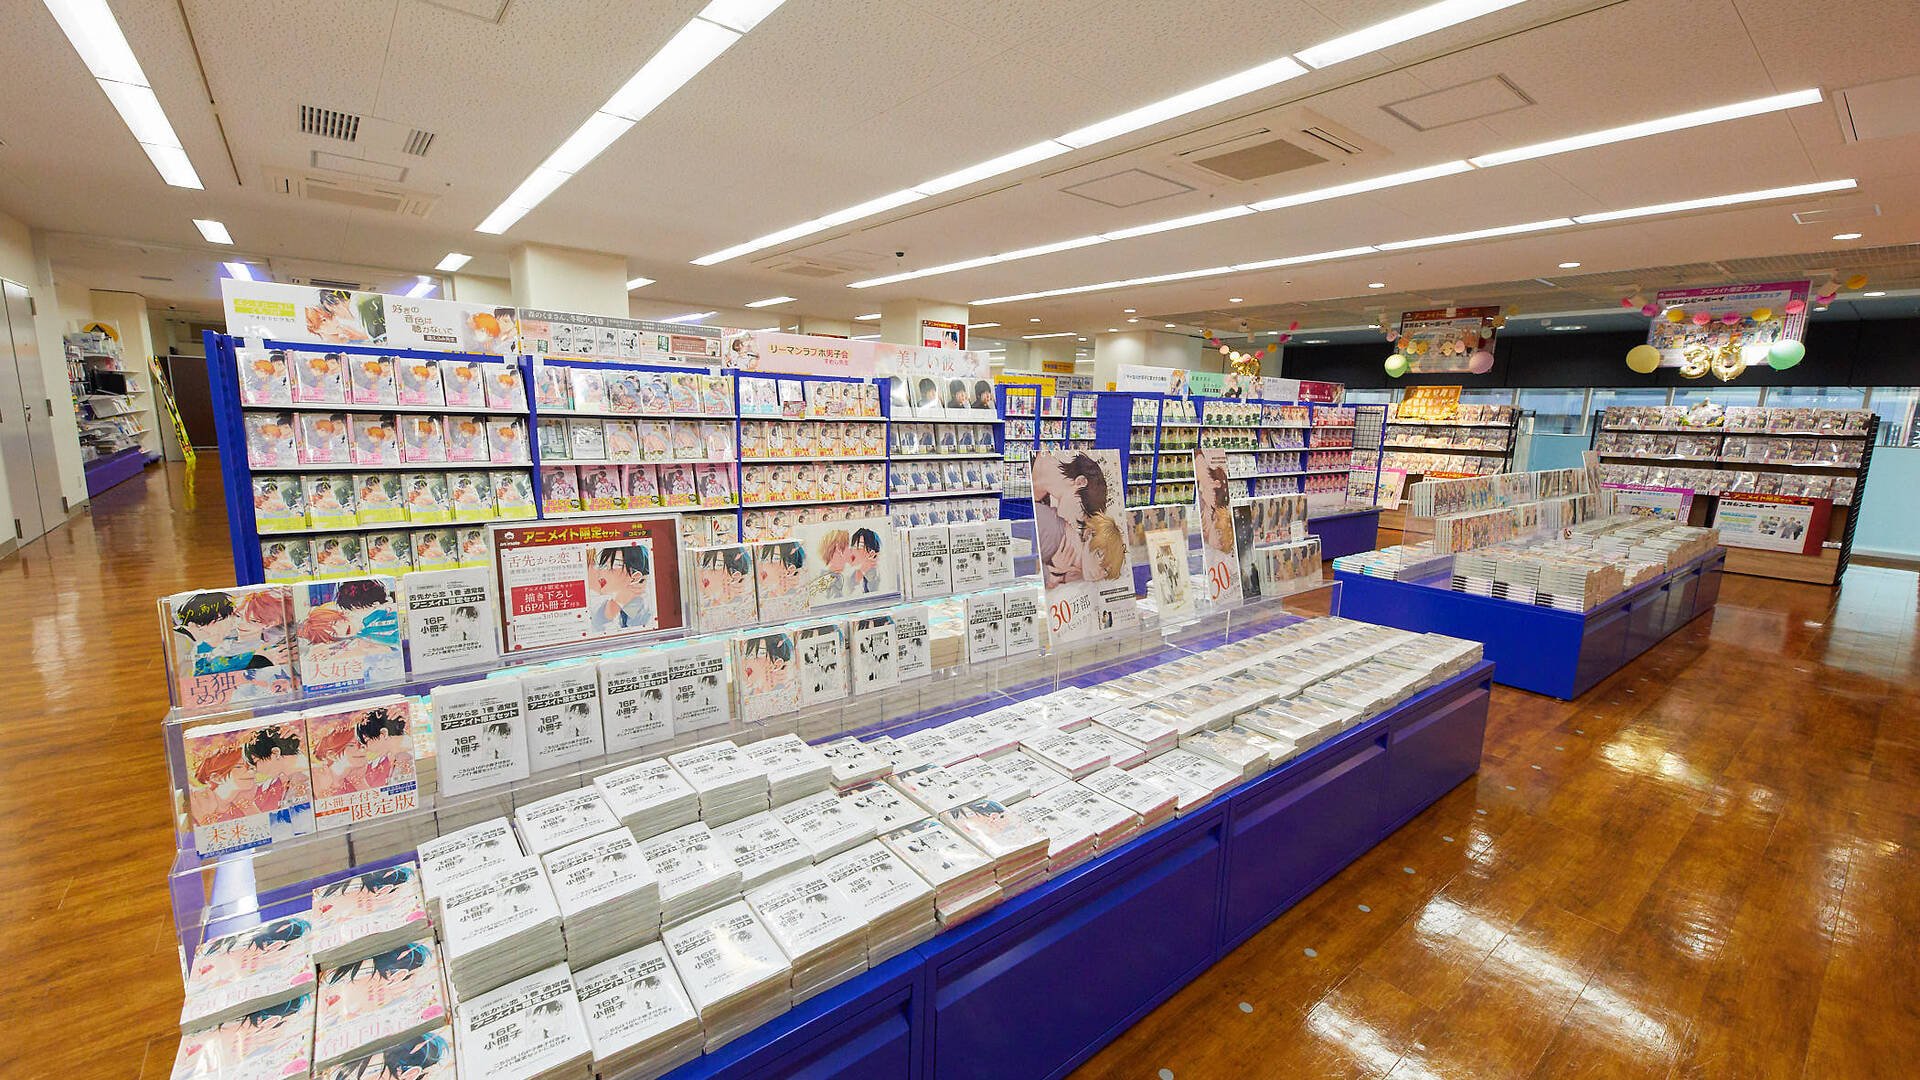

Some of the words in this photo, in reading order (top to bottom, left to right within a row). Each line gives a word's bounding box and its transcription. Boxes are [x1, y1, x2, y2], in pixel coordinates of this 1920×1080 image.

[769, 344, 849, 359] リーマンラブホ男子会
[522, 527, 621, 544] アニメイト限定セット
[508, 551, 570, 569] 舌先から恋
[525, 590, 573, 603] 描き下ろし
[424, 616, 445, 626] 16P
[421, 623, 449, 634] 小冊子
[313, 660, 362, 679] 大好き
[540, 714, 559, 725] 16P
[454, 735, 476, 746] 16P
[451, 742, 480, 755] 小冊子
[351, 791, 416, 822] 限定版
[209, 824, 249, 844] 未来
